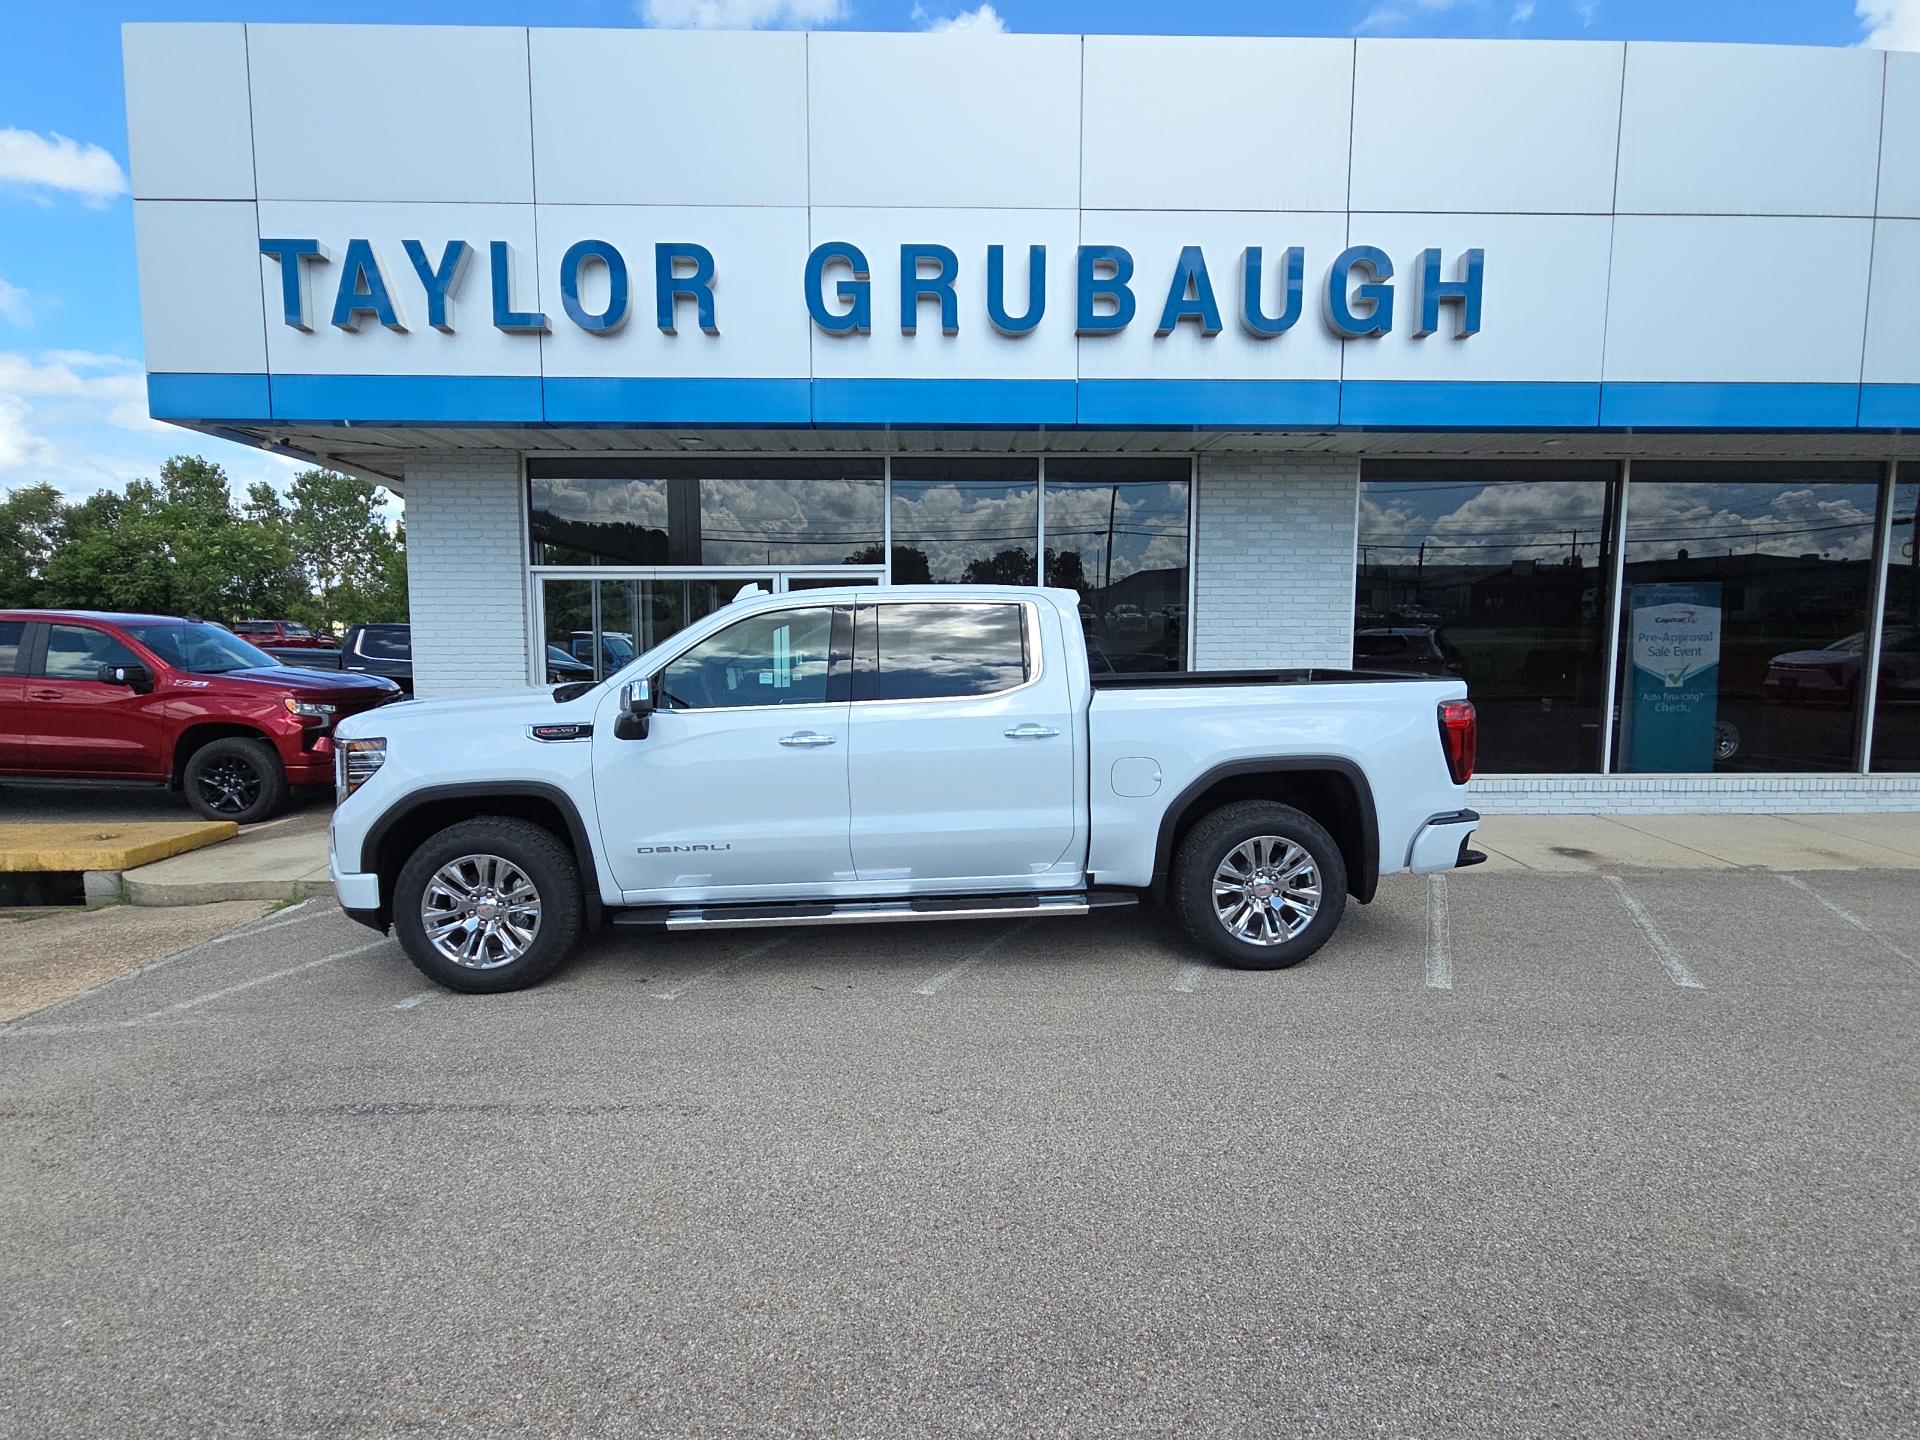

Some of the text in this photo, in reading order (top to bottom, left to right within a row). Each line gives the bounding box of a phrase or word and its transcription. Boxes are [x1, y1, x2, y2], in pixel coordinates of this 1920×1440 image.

[259, 239, 1485, 337] TAYLOR GRUBAUGH
[1638, 631, 1714, 645] Pre-Approval
[1647, 646, 1703, 657] Sale Event
[1642, 692, 1704, 703] Auto financing?
[1654, 702, 1691, 713] Check.
[636, 843, 731, 854] DENALI
